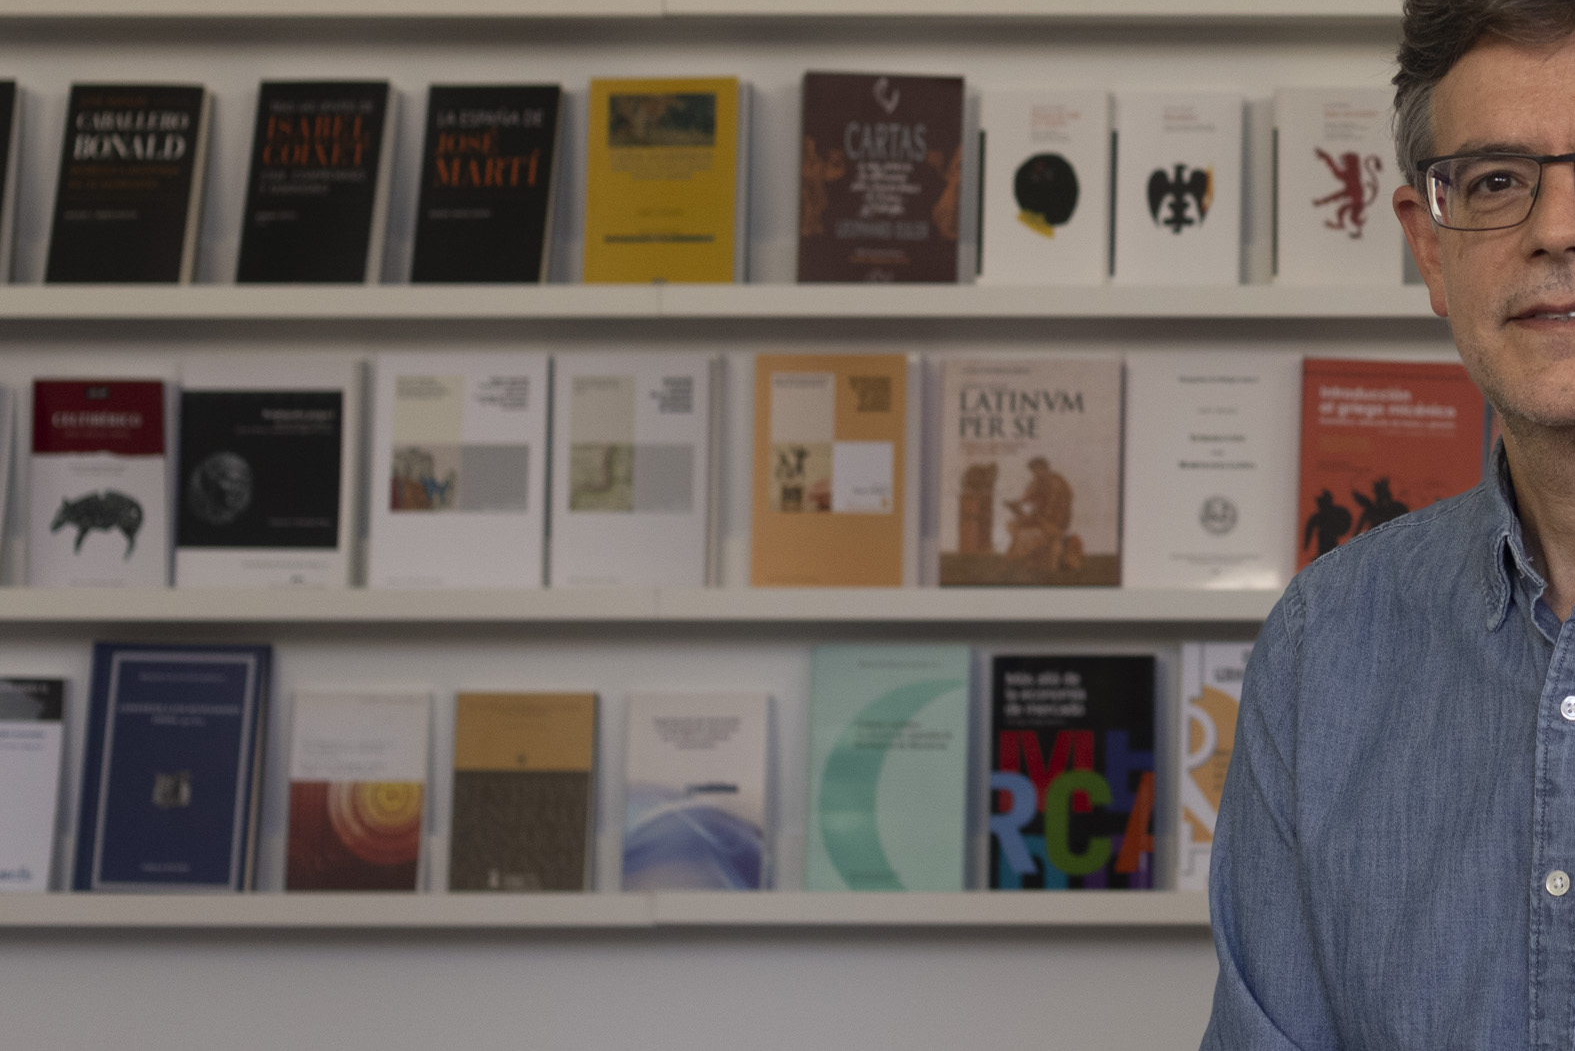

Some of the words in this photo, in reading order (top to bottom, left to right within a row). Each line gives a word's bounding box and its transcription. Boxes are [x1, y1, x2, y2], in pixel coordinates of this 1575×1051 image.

[75, 110, 189, 132] CABALLERO
[436, 109, 455, 128] LA
[460, 106, 519, 128] ESPAÑA
[523, 107, 543, 127] DE
[72, 132, 187, 162] BONALD
[434, 126, 498, 155] JOSÉ
[844, 120, 928, 162] CARTAS
[434, 150, 541, 188] MARTÍ
[959, 390, 1085, 413] LATINVM
[1319, 386, 1412, 401] Introducción
[959, 415, 1005, 439] PER
[1013, 415, 1040, 439] SE
